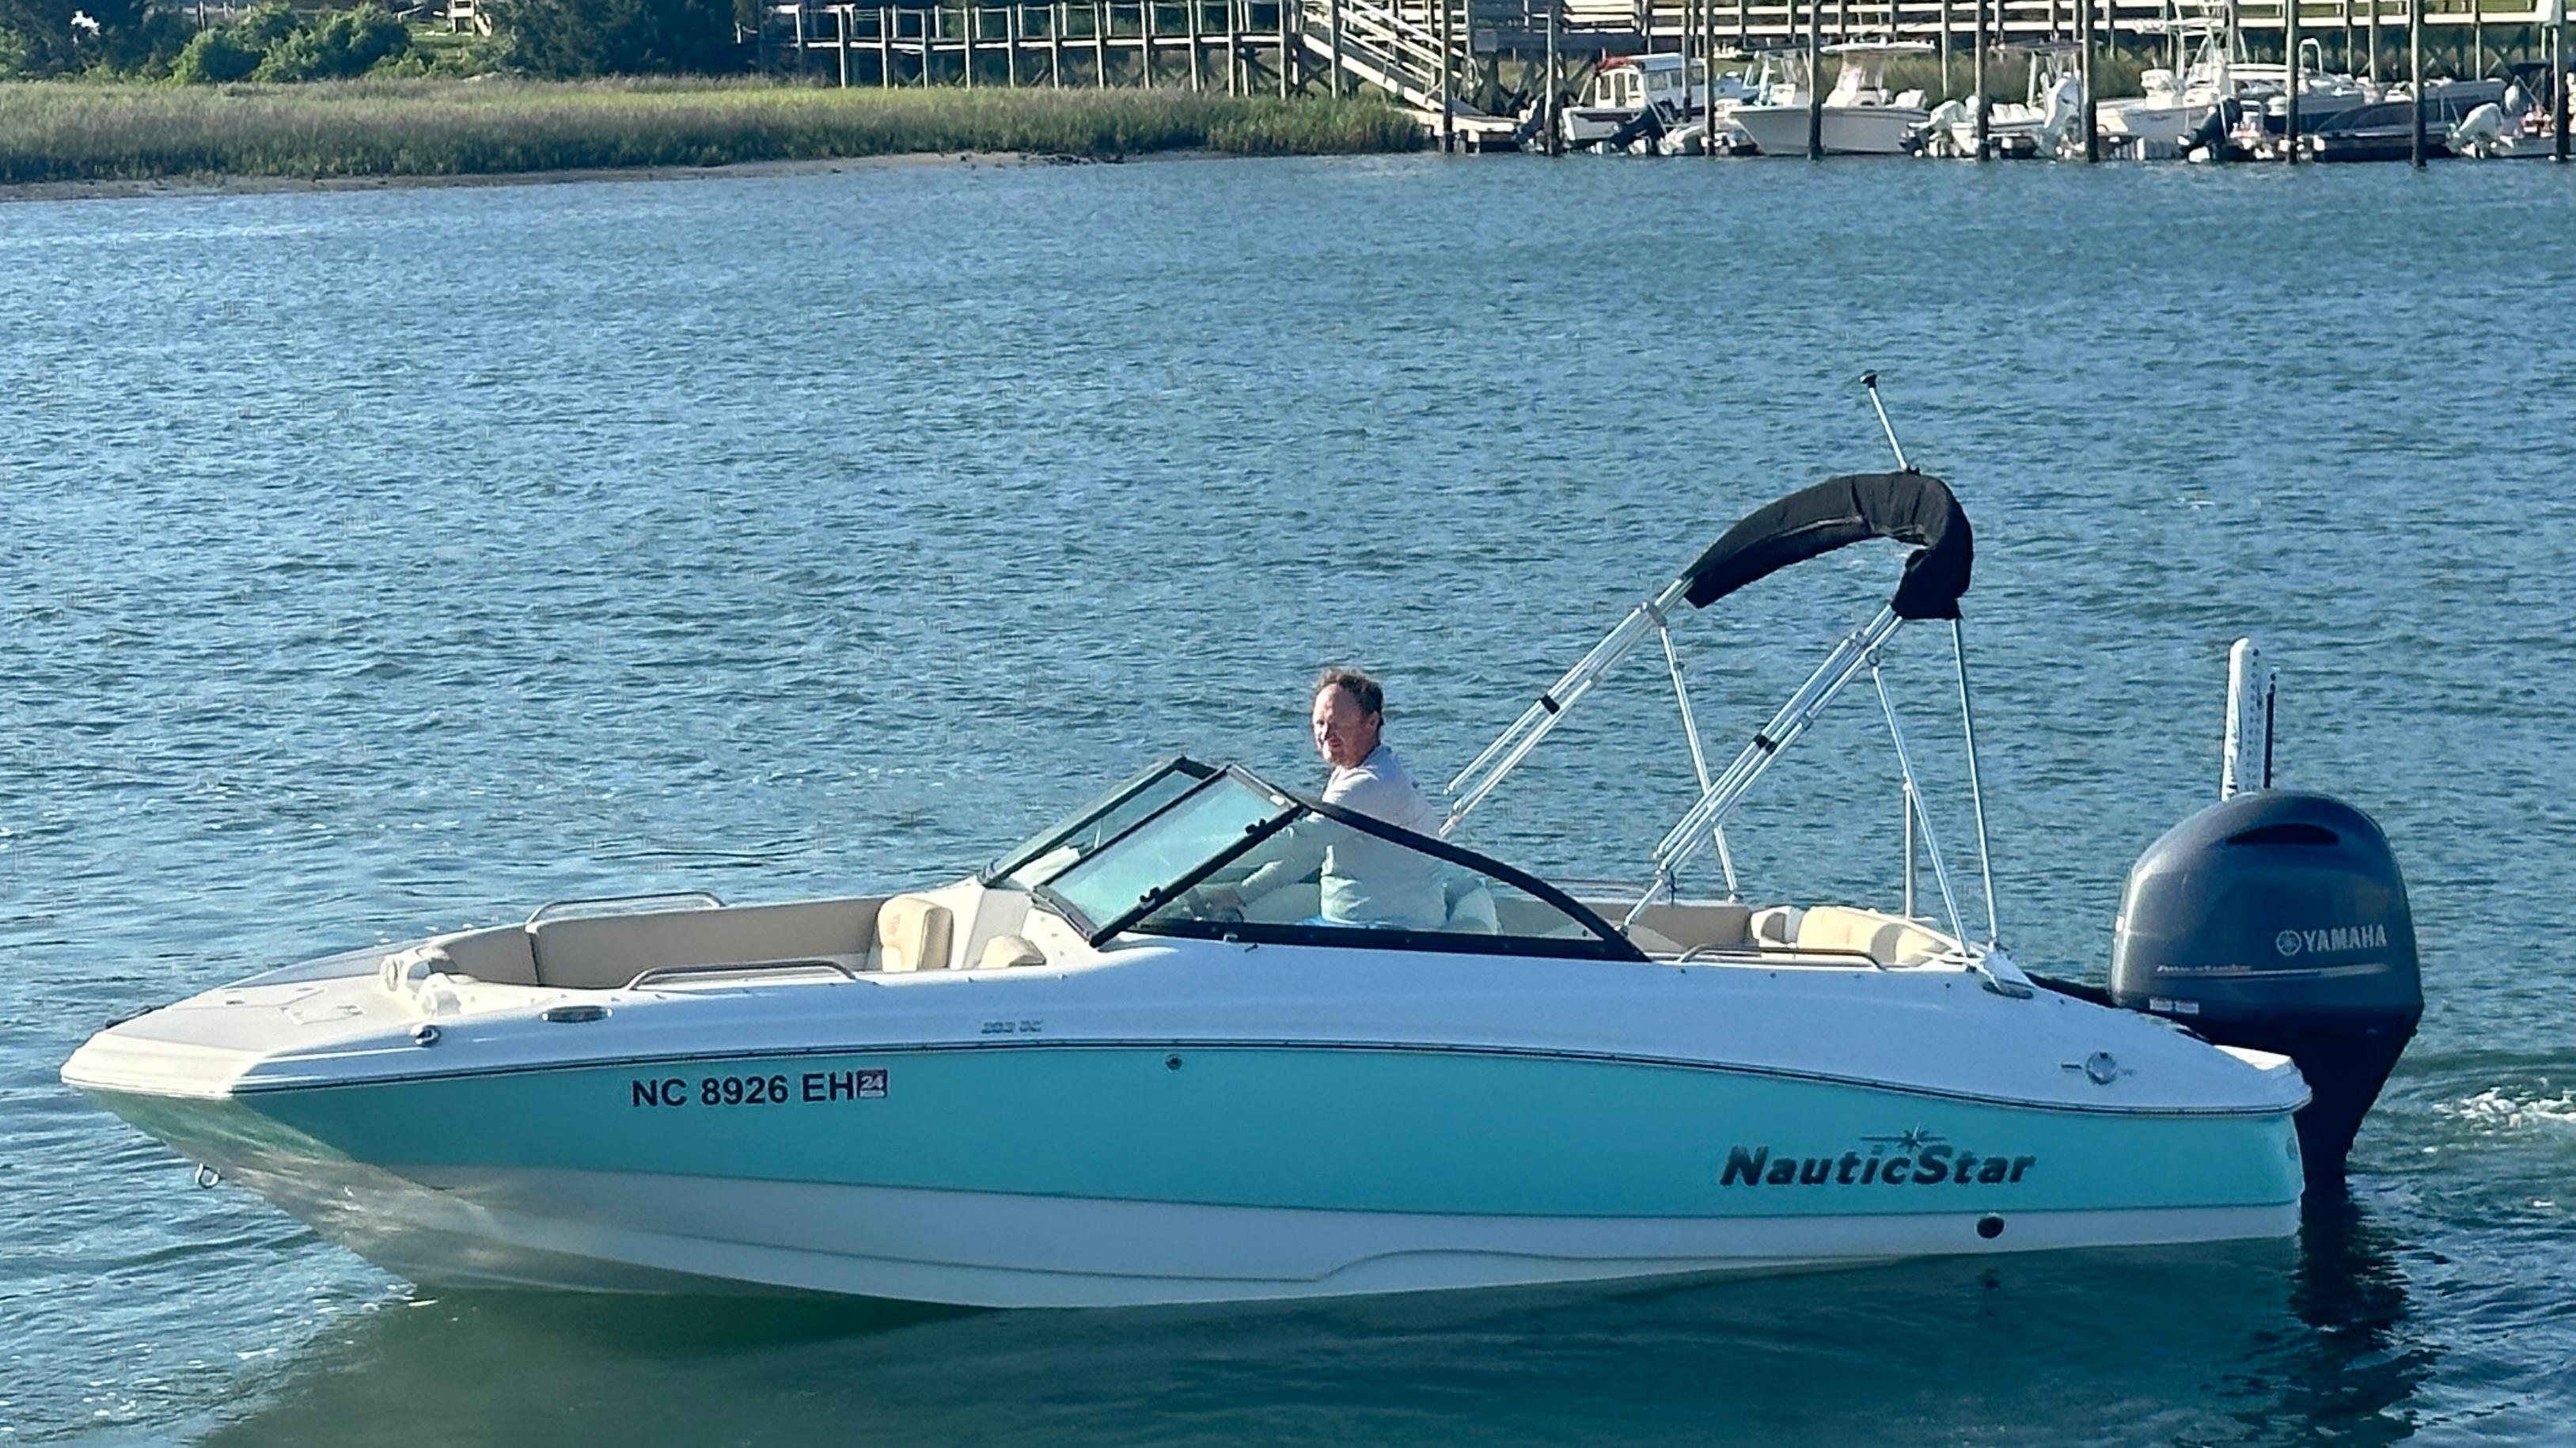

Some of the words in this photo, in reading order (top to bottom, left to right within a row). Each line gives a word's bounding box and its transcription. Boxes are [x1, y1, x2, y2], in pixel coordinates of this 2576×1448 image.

[2301, 923, 2387, 952] YAMAHA
[632, 1078, 687, 1107] NC
[701, 1075, 788, 1105] 8926
[802, 1071, 854, 1101] EH
[860, 1075, 884, 1089] 24
[1720, 1145, 2037, 1186] NauticStar
